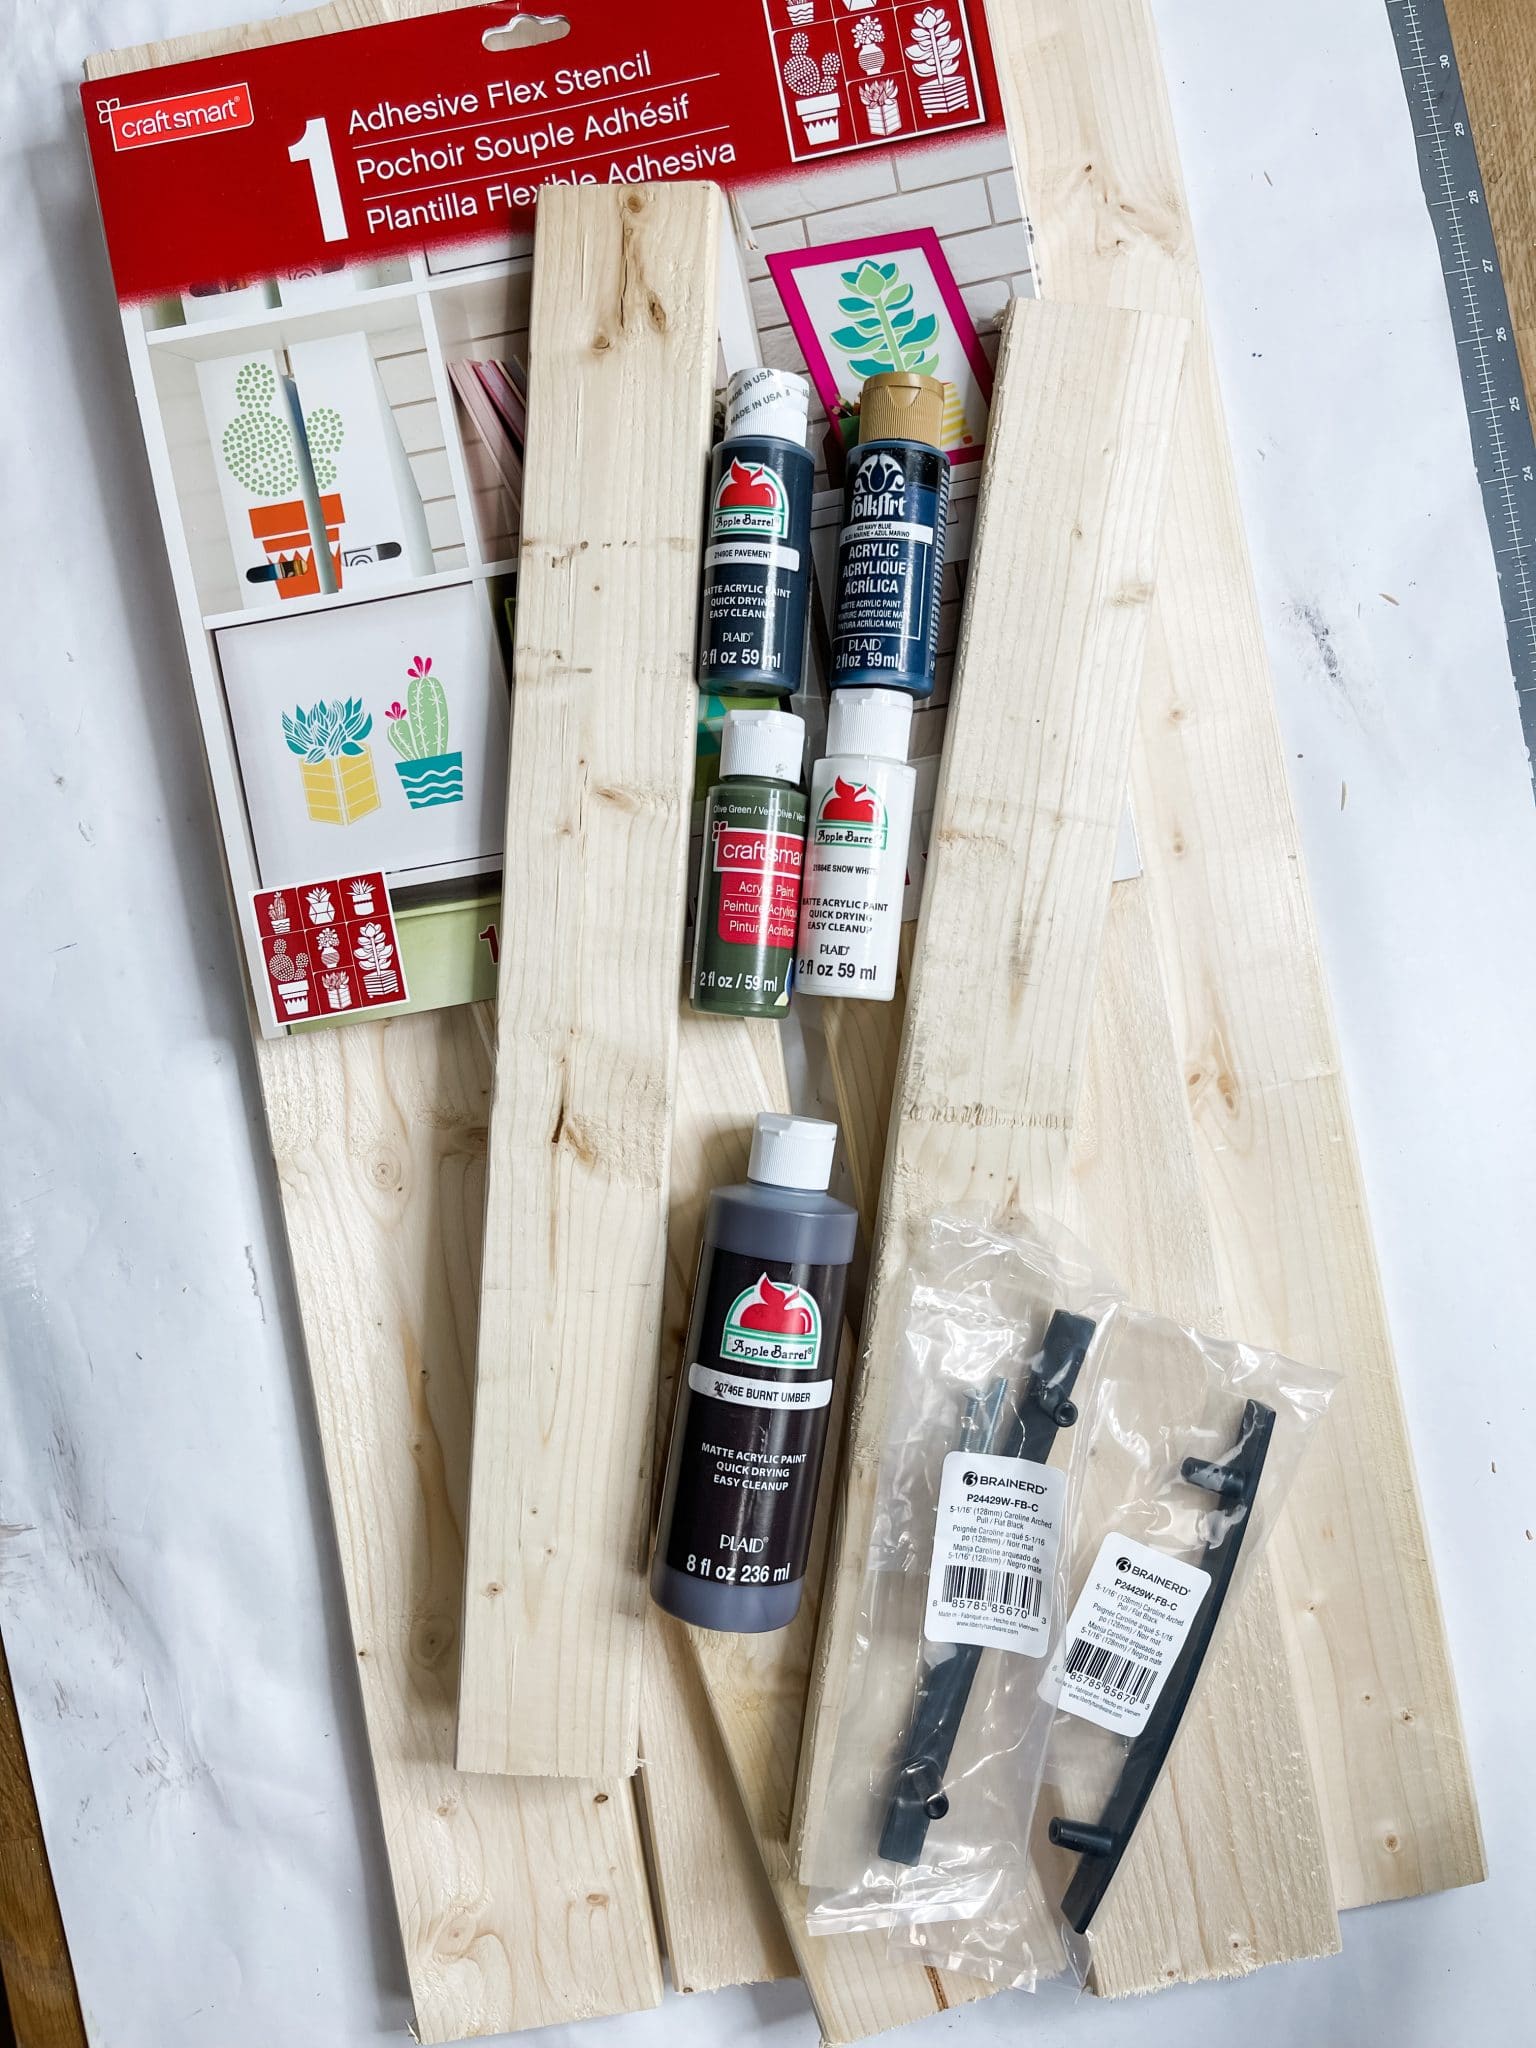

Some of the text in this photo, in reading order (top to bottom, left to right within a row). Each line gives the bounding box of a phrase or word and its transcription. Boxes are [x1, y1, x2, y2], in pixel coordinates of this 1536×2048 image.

[1439, 54, 1450, 69] 30
[348, 49, 652, 136] Adhesive Flex Stencil
[121, 98, 238, 139] craft smart
[1454, 122, 1465, 137] 29
[356, 92, 690, 184] Pochoir Souple Adhésif
[287, 116, 349, 243] 1
[366, 191, 479, 235] Plantilla
[606, 142, 737, 186] Adhesiva
[1468, 189, 1479, 205] 28
[1482, 258, 1494, 273] 27
[1496, 326, 1507, 342] 26
[743, 380, 753, 392] IN
[752, 369, 774, 384] USA
[730, 405, 751, 424] MADE
[752, 399, 763, 411] IN
[763, 391, 782, 405] USA
[1509, 396, 1521, 412] 25
[1522, 465, 1534, 482] 24
[715, 513, 774, 529] Apple Barrel
[734, 549, 772, 560] PAVEMENT
[848, 543, 899, 560] ACRYLIC
[842, 560, 907, 579] ACRYLIQUE
[724, 583, 764, 594] ACRYLIC
[844, 576, 899, 596] ACRÍLICA
[710, 596, 736, 607] QUICK
[856, 599, 881, 608] ACRYLIC
[882, 600, 902, 609] PAINT
[709, 608, 729, 619] EASY
[857, 610, 892, 618] ACRYLIQUE
[722, 632, 751, 643] PLAID
[848, 638, 882, 652] PLAID
[702, 651, 708, 666] 2
[709, 648, 717, 665] fl
[720, 651, 737, 664] oz
[741, 648, 760, 666] 59
[836, 652, 899, 670] 2 fl oz 59 ml
[728, 804, 752, 815] Green
[817, 829, 873, 844] Apple Barre
[723, 840, 767, 861] craft
[832, 864, 854, 874] SNOW
[776, 884, 795, 898] Paint
[822, 898, 861, 909] ACRYLIC
[863, 901, 889, 912] PAINT
[809, 909, 834, 920] QUICK
[808, 921, 827, 931] EASY
[819, 943, 849, 956] PLAID
[799, 959, 877, 981] 2 fl oz 59 ml
[700, 971, 707, 987] 2
[708, 970, 716, 987] fl
[718, 975, 733, 989] oz
[744, 974, 761, 990] 59
[763, 976, 778, 993] ml
[731, 1338, 807, 1361] Apple Barrel
[746, 1388, 779, 1402] BURNT
[780, 1391, 811, 1403] UMBER
[701, 1442, 807, 1465] MATTE ACRYLIC PAINT
[716, 1461, 790, 1478] QUICK DRYING
[713, 1473, 789, 1492] EASY CLEANUP
[979, 1475, 1045, 1495] BRAINERD
[966, 1493, 1039, 1513] P24429W-FB-C
[976, 1515, 989, 1524] Pull
[1006, 1519, 1024, 1530] Black
[1004, 1510, 1030, 1523] Caroline
[1030, 1516, 1053, 1529] Arched
[978, 1526, 1005, 1537] Caroline
[719, 1533, 764, 1554] PLAID
[974, 1545, 1001, 1556] Caroline
[1006, 1539, 1021, 1549] Noir
[1021, 1543, 1035, 1552] mat
[686, 1553, 791, 1583] 8 fl oz 236 ml
[1006, 1558, 1027, 1570] Negro
[1131, 1565, 1189, 1597] BRAINERD
[1114, 1578, 1178, 1611] P24429W-FB-C
[951, 1598, 988, 1612] 85785
[991, 1603, 1028, 1620] 85670
[1069, 1671, 1101, 1690] 85785
[1103, 1685, 1136, 1705] 85670
